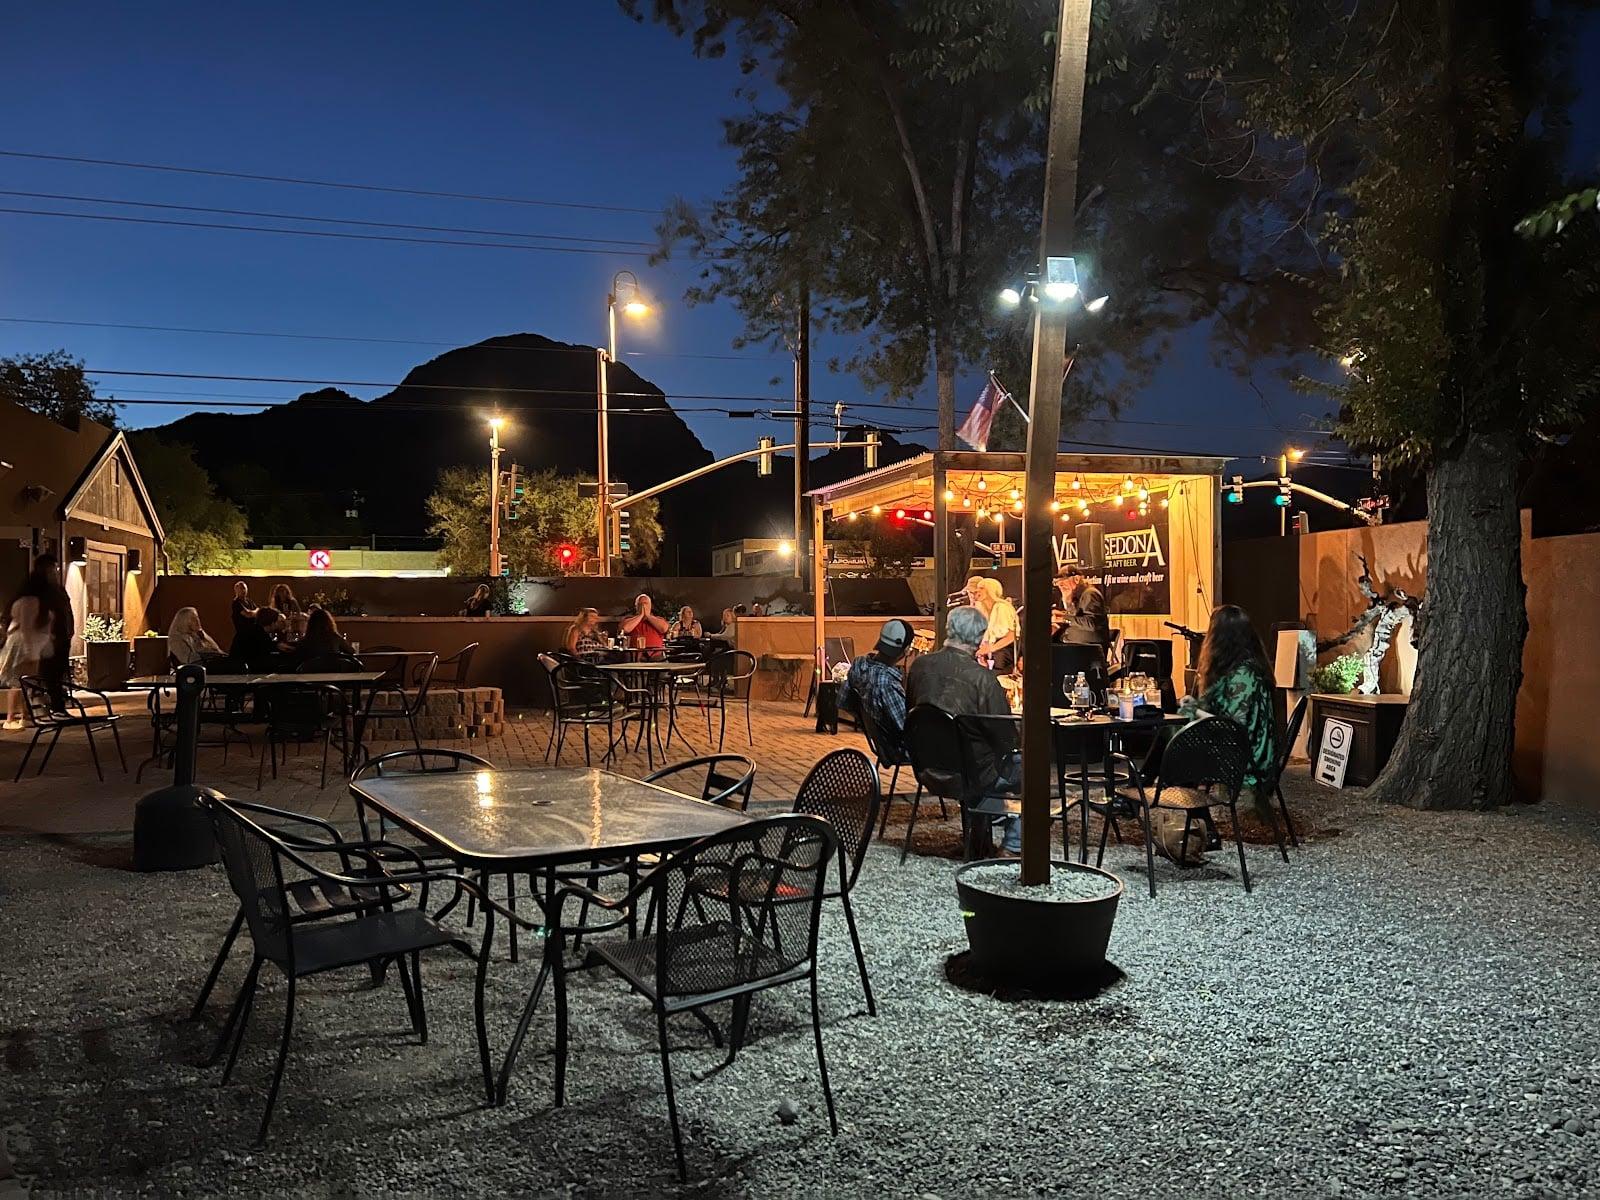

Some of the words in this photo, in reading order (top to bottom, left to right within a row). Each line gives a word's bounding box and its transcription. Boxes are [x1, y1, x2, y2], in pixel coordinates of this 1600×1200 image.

[1052, 534, 1078, 572] VIN
[1123, 558, 1138, 568] BEER
[1116, 573, 1129, 584] wine
[1128, 572, 1140, 583] and
[1139, 571, 1152, 586] craft
[1152, 571, 1164, 583] beer
[1324, 756, 1341, 766] SMOKING
[1326, 764, 1336, 772] AREA
